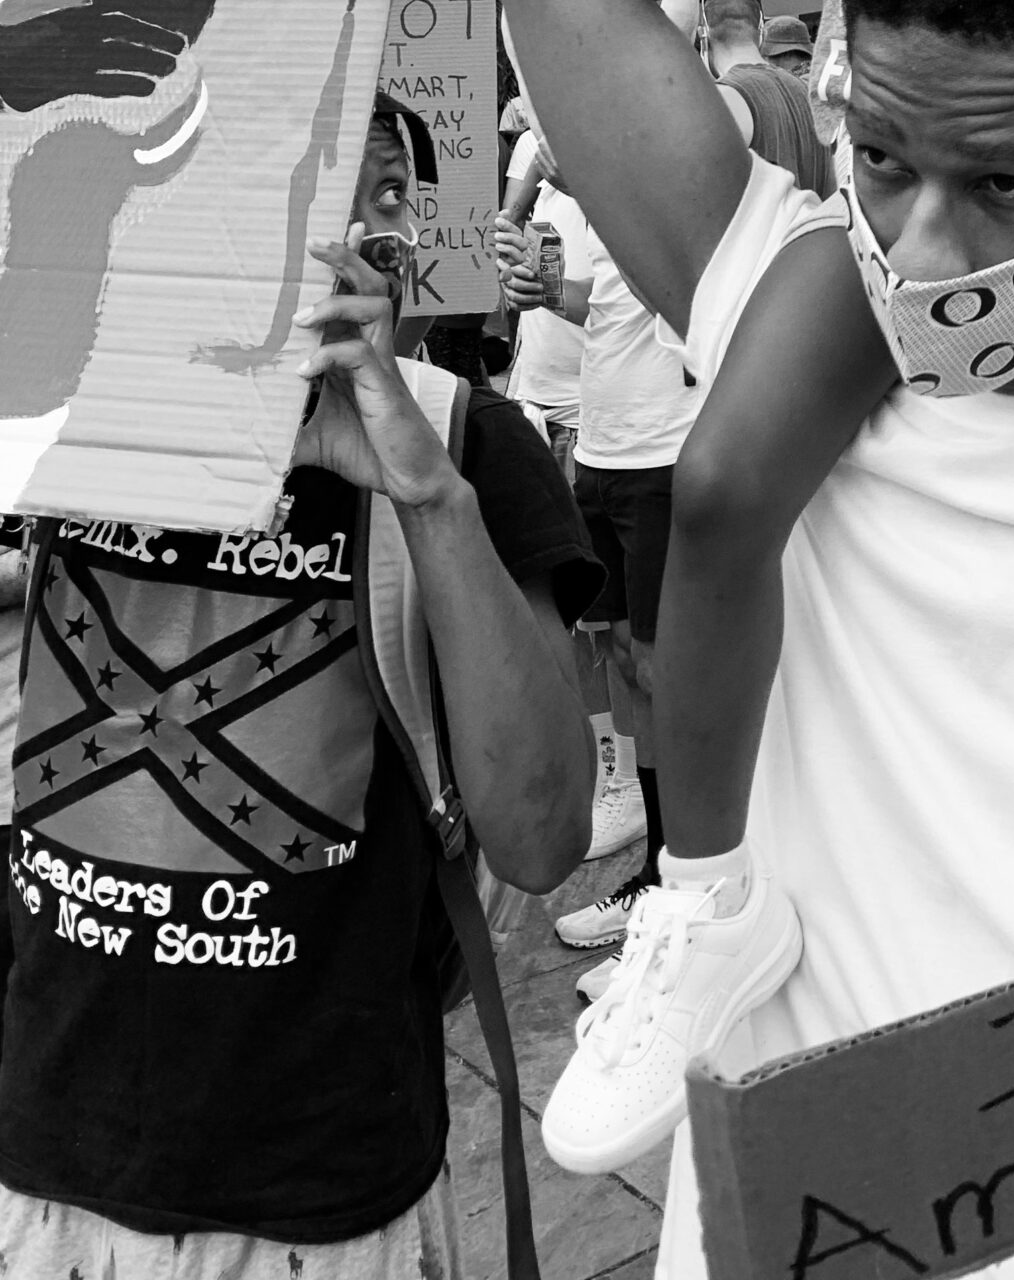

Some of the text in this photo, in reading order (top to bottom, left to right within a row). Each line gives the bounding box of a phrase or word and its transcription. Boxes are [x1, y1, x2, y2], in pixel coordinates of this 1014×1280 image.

[418, 225, 488, 250] CALLY
[207, 531, 352, 581] Rebel
[20, 829, 270, 921] Leaders Of
[323, 840, 357, 867] TM
[55, 896, 132, 957] New
[154, 923, 297, 967] South
